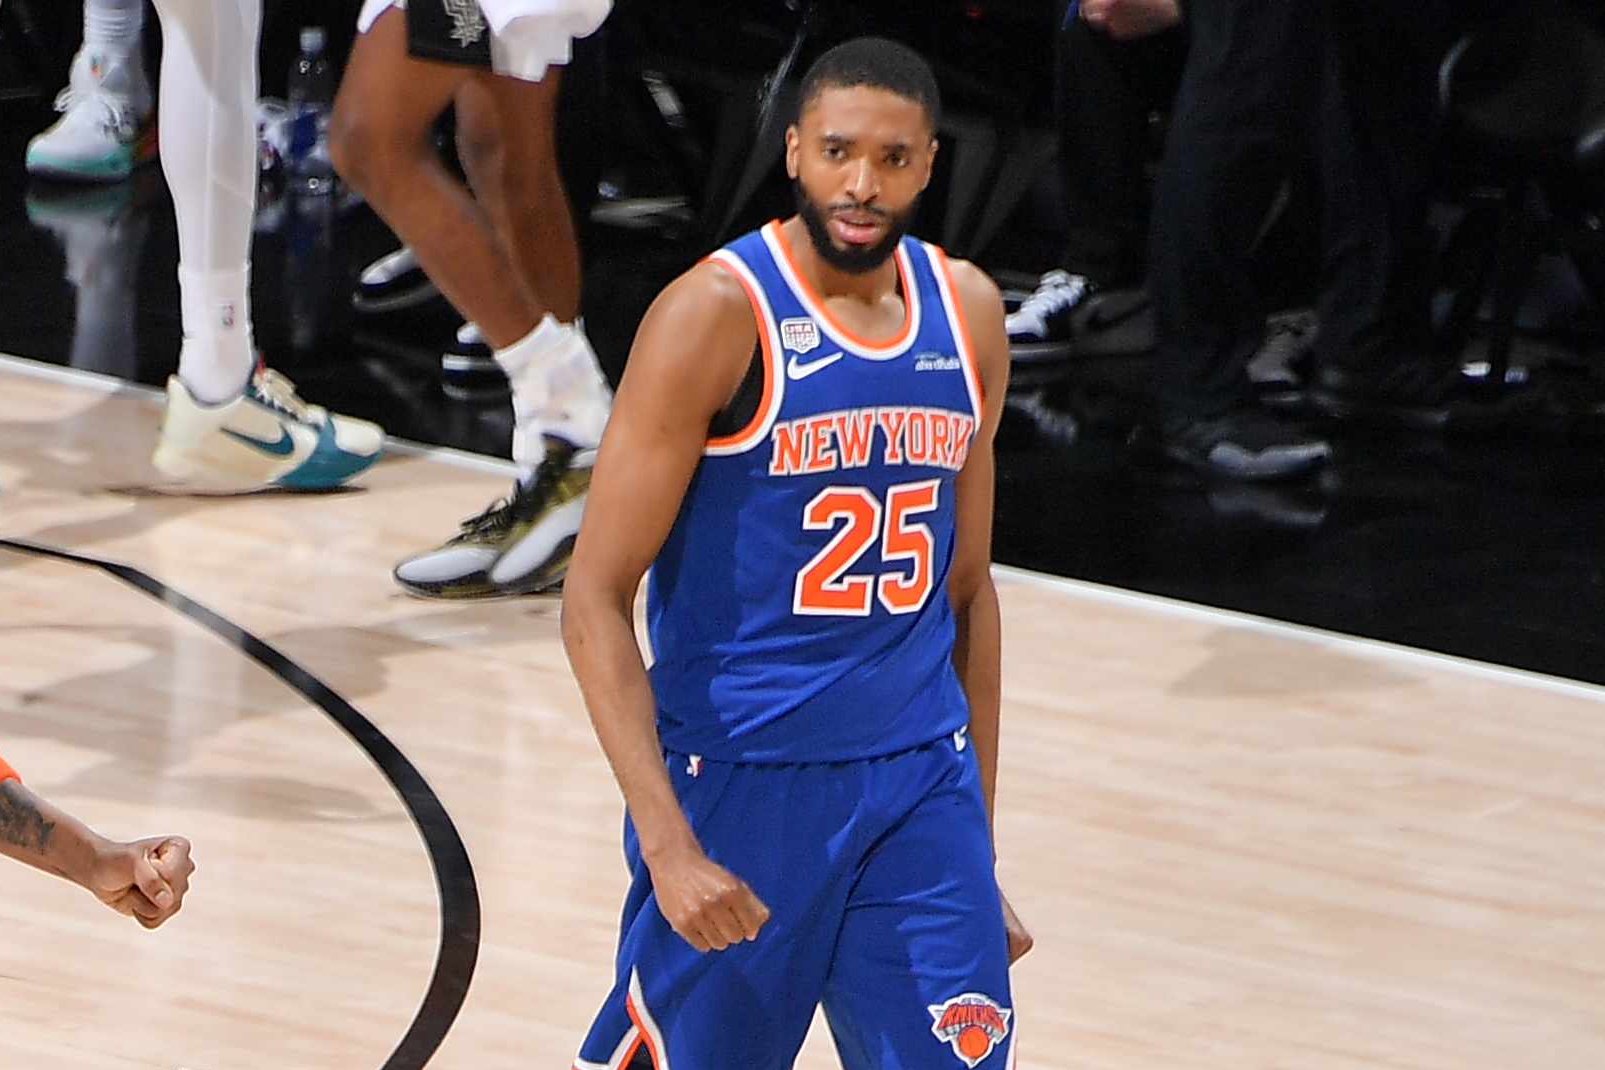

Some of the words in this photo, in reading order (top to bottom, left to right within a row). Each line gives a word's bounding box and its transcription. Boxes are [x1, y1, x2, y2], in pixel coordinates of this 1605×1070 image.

[768, 406, 877, 477] NEW
[878, 405, 974, 472] YORK
[792, 477, 942, 616] 25
